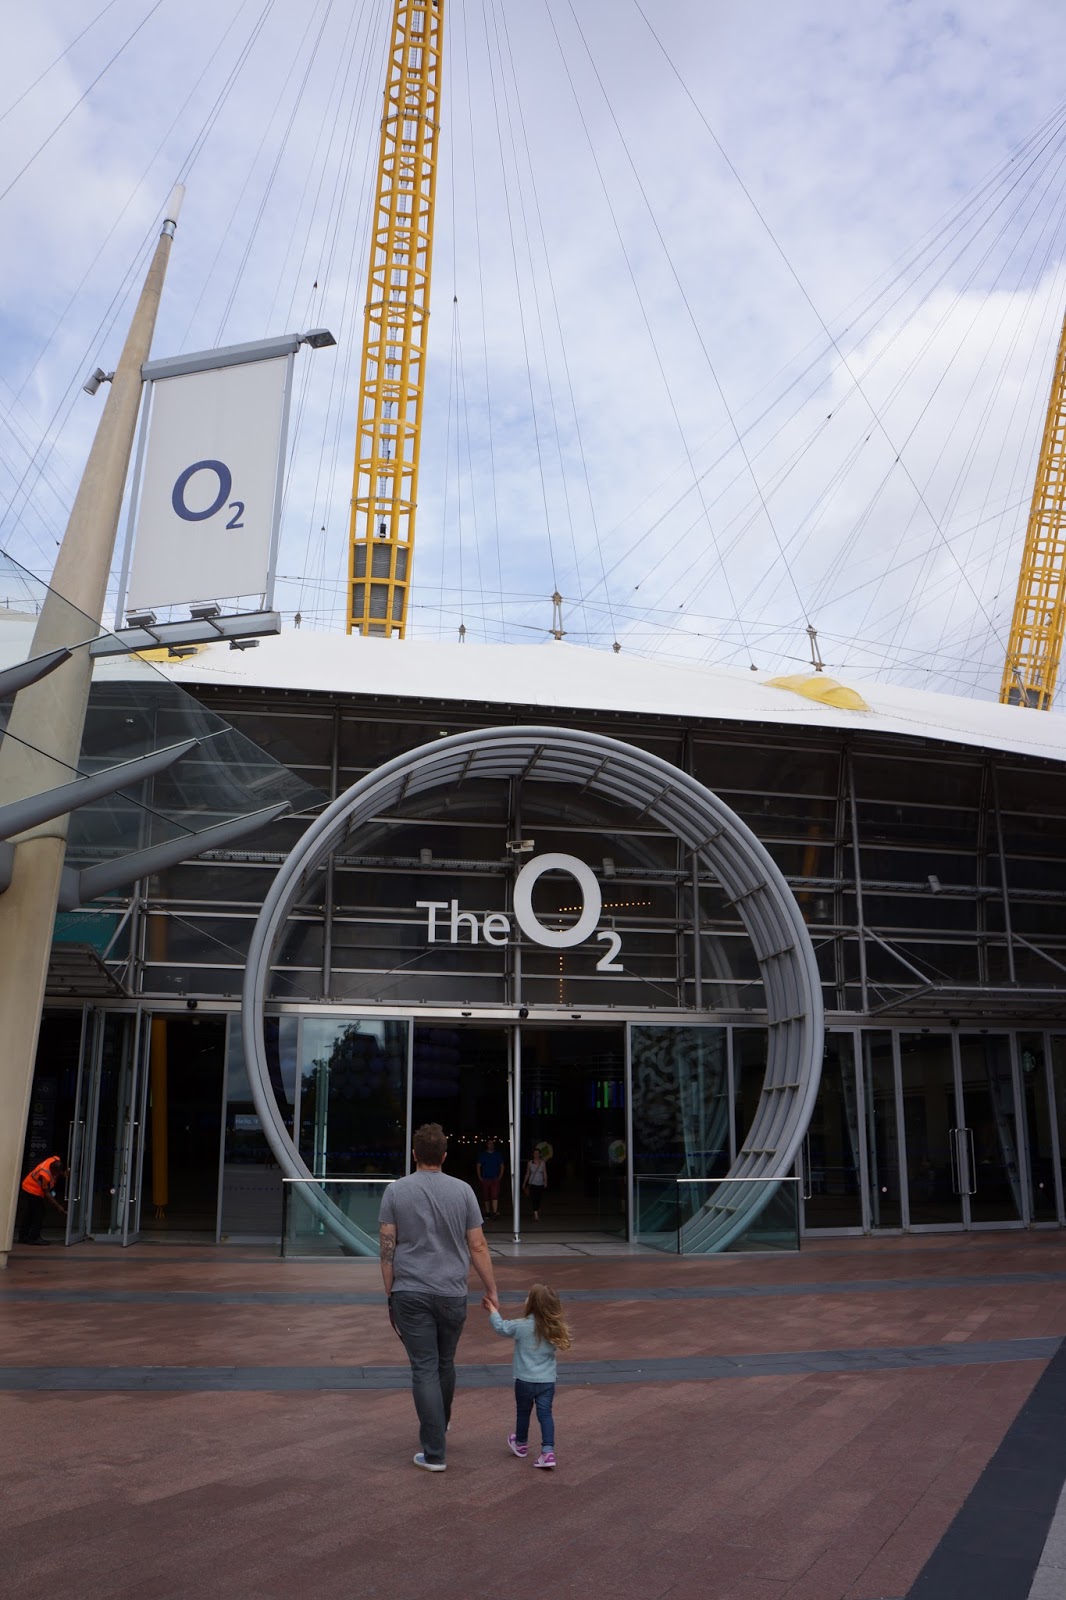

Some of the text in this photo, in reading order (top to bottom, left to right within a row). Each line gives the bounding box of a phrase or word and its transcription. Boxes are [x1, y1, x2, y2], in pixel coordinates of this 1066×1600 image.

[171, 459, 245, 530] O2
[416, 852, 624, 972] The O2
